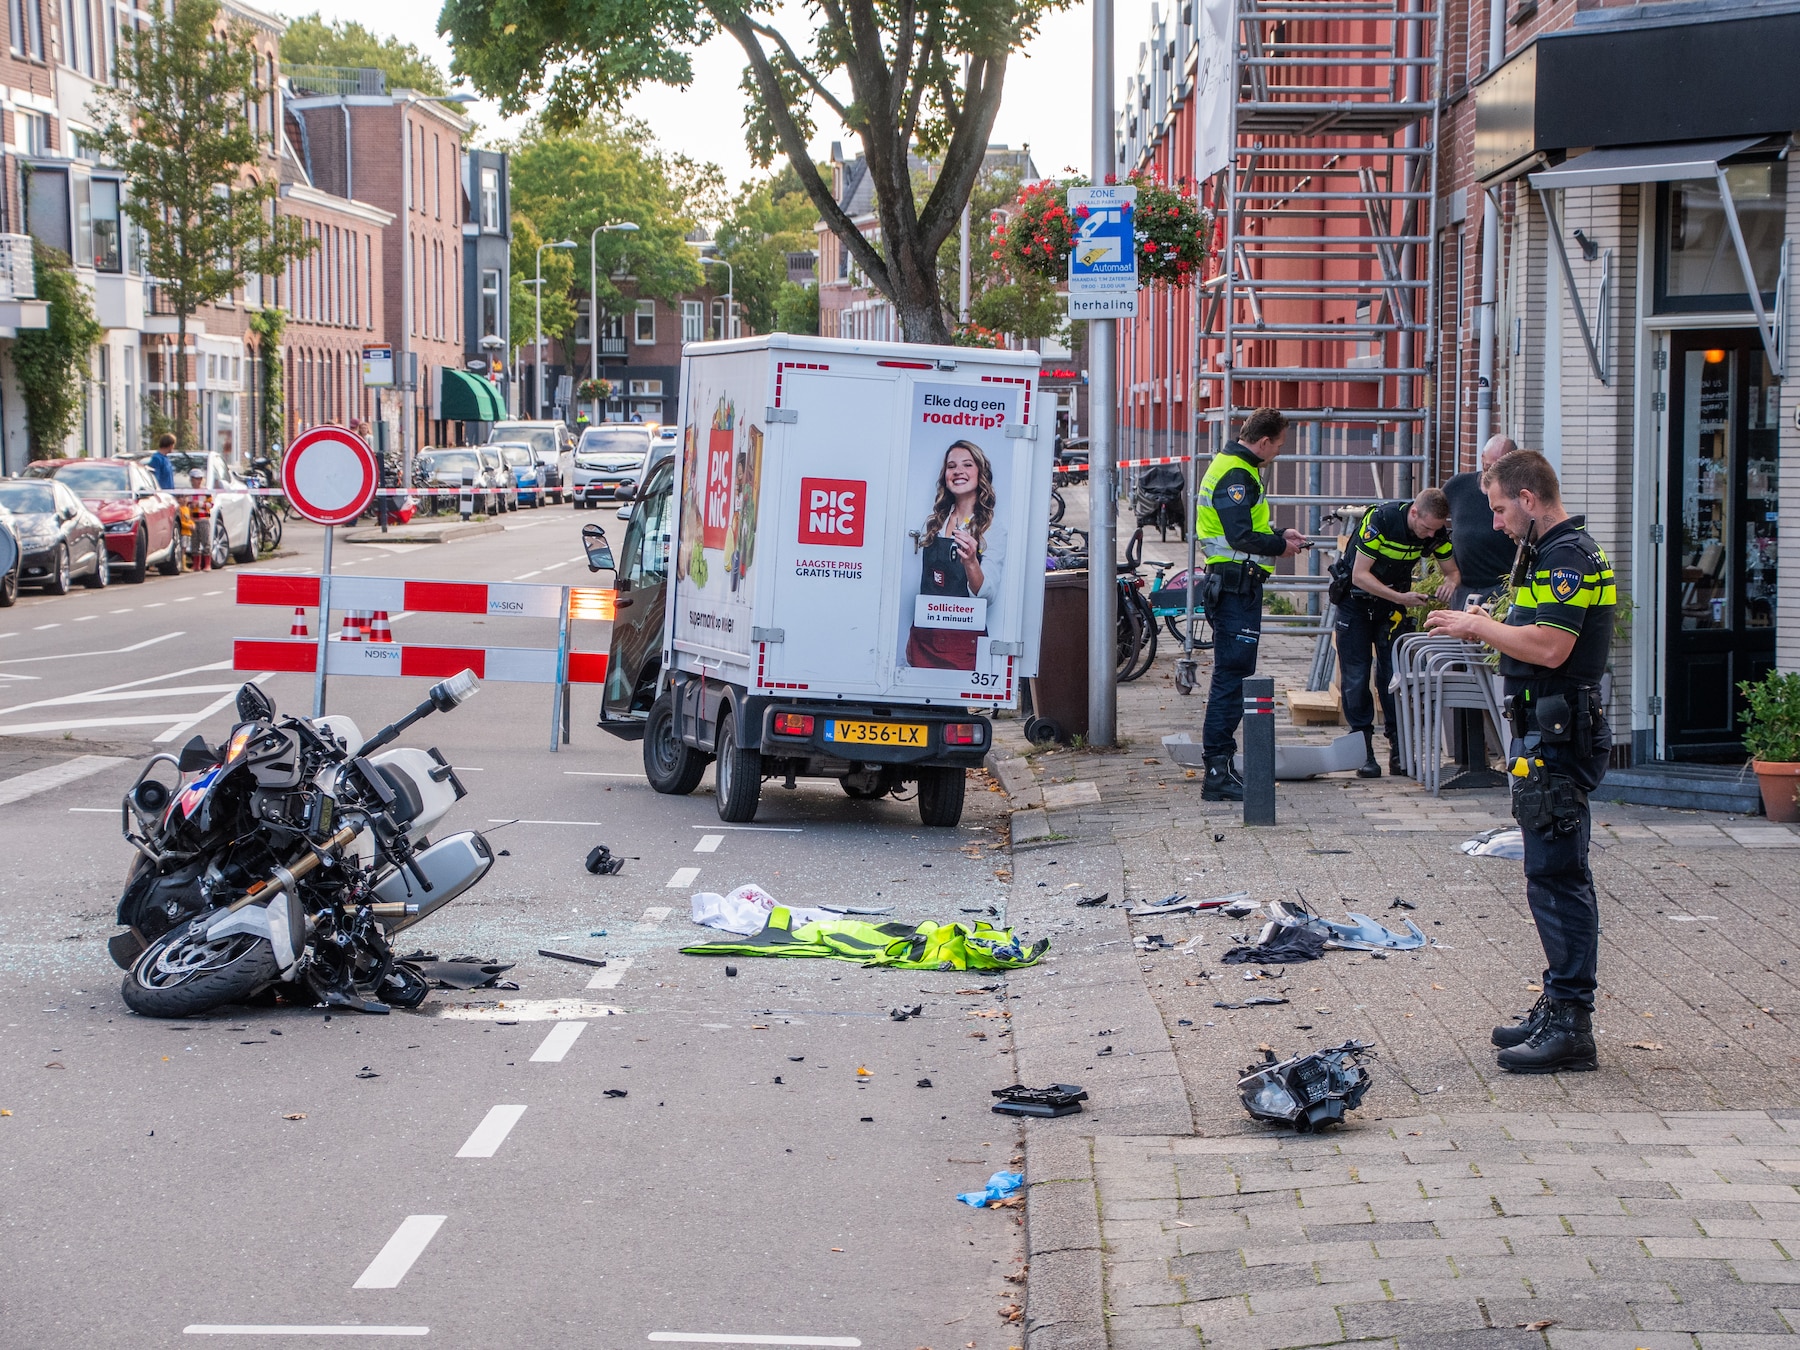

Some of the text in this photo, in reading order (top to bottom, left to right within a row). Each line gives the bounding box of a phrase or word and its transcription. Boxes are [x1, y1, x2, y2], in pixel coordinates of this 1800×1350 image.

[1090, 189, 1115, 198] ZONE
[1092, 262, 1132, 273] Automaat
[1073, 300, 1134, 312] herhaling
[924, 394, 1005, 412] Elke dag een
[922, 412, 1005, 430] roadtrip?
[710, 450, 730, 489] PIC
[1760, 463, 1777, 473] OPEN
[810, 489, 856, 513] PIC
[796, 559, 863, 570] LAAGSTE PRIJS
[795, 567, 862, 579] GRATIS THUIS
[1553, 570, 1579, 581] POLITIE
[489, 601, 524, 610] W-SIGN
[927, 603, 975, 613] Solliciteer
[927, 613, 935, 621] in
[942, 615, 974, 623] minuut!
[364, 650, 400, 659] W-SIGN
[971, 672, 999, 687] 357
[840, 723, 920, 744] V-356-LX
